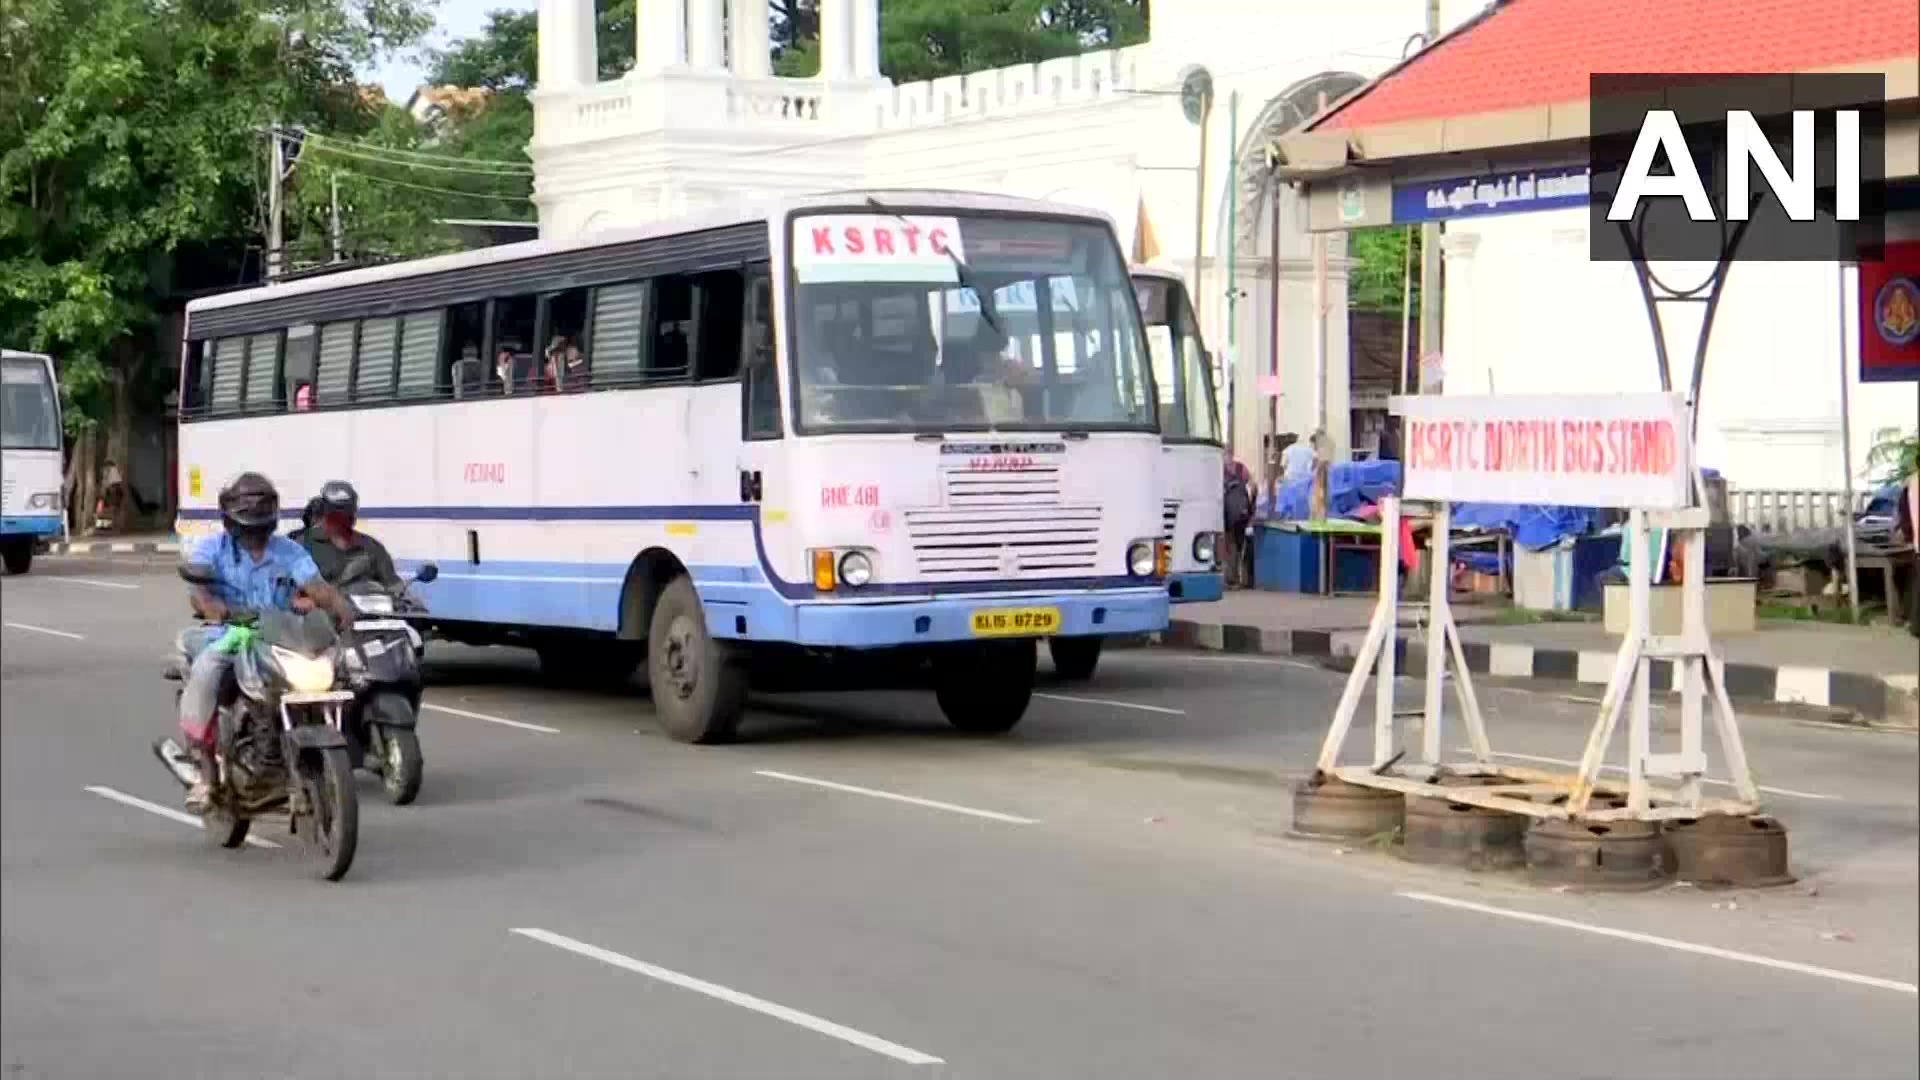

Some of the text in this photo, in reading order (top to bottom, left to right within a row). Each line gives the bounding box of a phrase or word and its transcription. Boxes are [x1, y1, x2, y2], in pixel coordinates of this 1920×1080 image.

[811, 223, 948, 257] KSRTC
[1410, 418, 1676, 474] KSRTC NORTH BUS STAND
